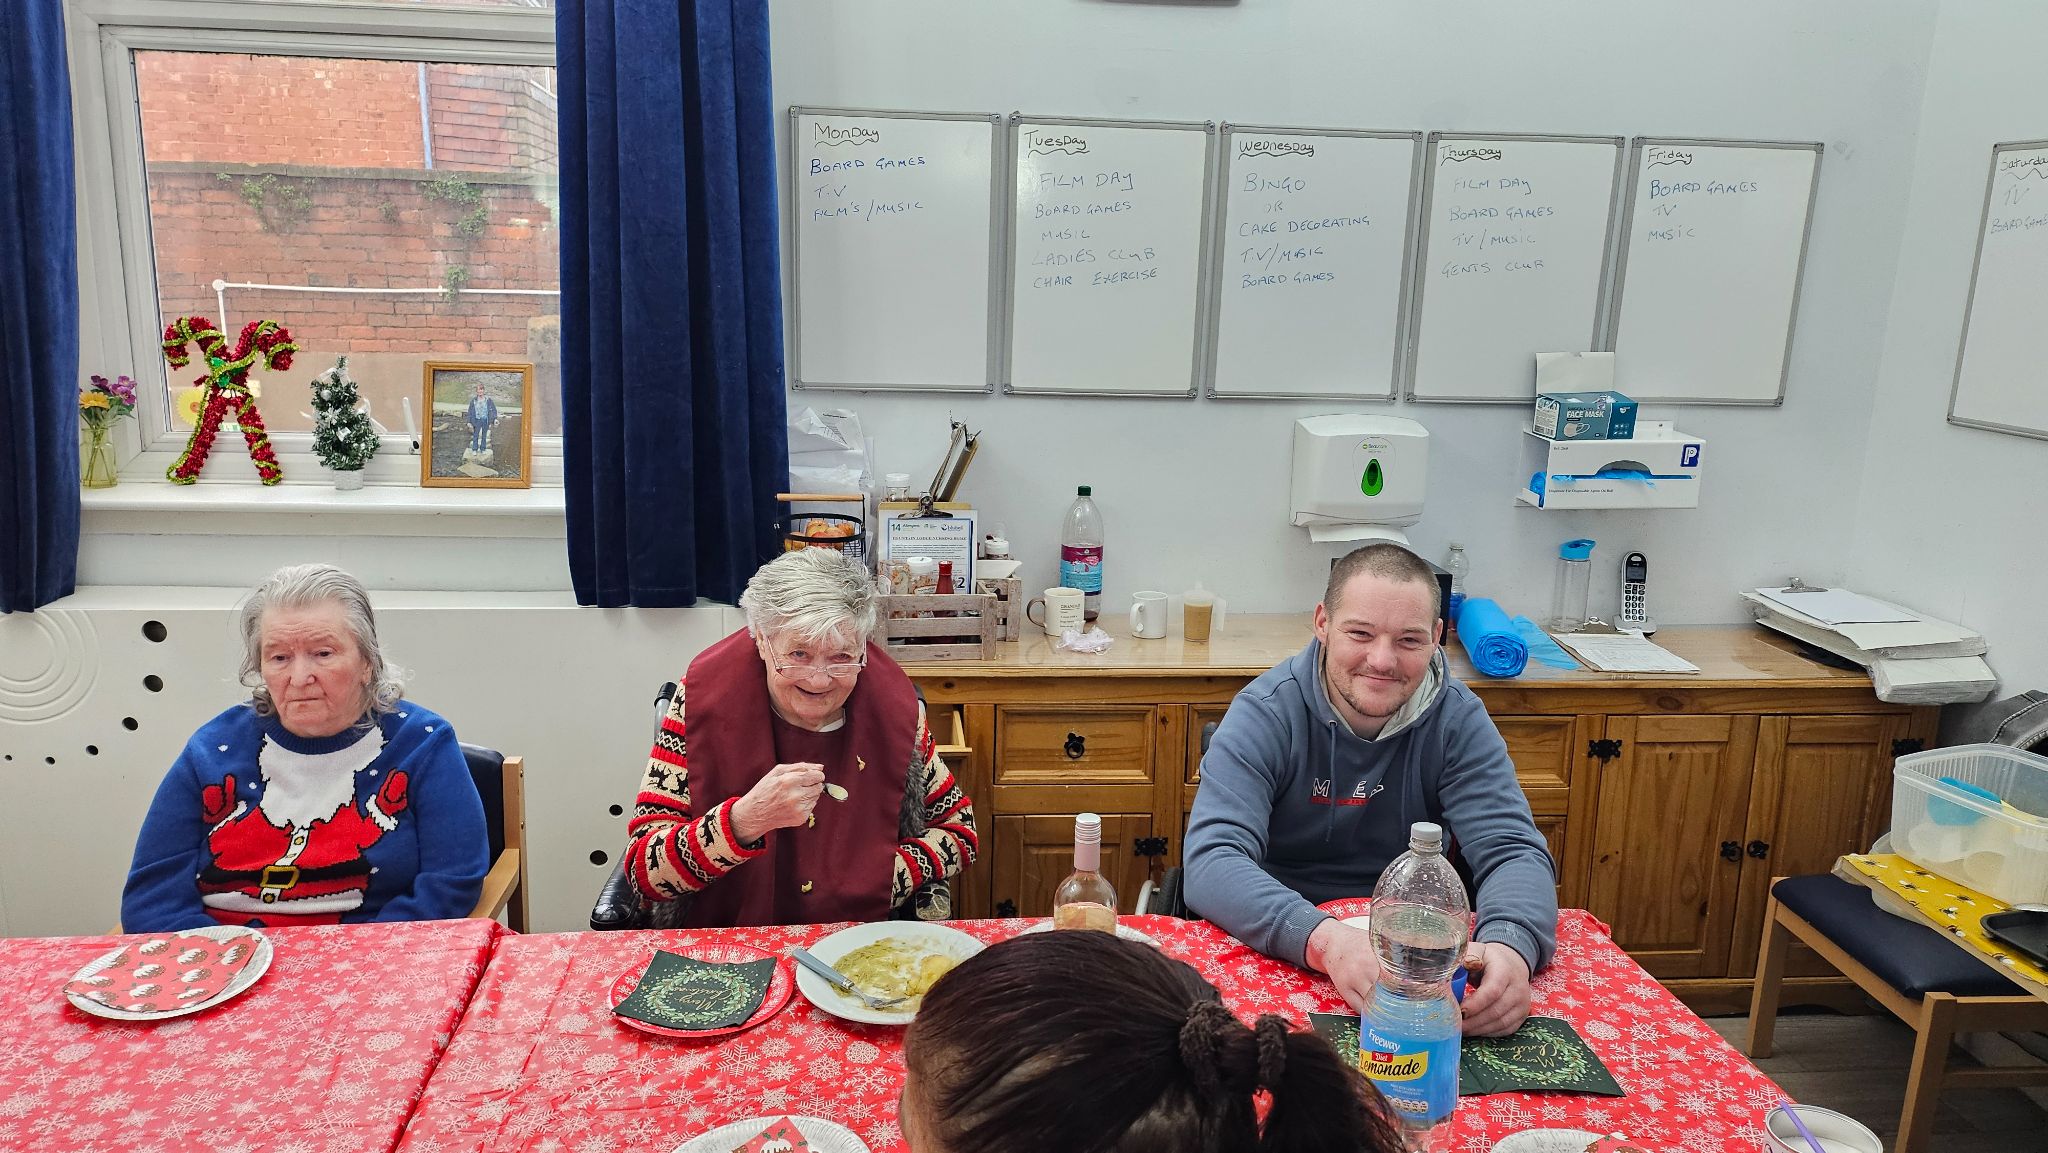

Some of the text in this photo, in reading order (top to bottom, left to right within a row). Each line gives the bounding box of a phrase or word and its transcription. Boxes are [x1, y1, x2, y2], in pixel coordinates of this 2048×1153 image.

[1648, 147, 1692, 165] Friday
[810, 156, 926, 176] BOARD GAMES
[1040, 172, 1134, 191] FILM DAY
[1243, 172, 1306, 193] BINGO
[1454, 176, 1489, 193] FILM
[1651, 180, 1758, 199] BOARD GAMES
[1035, 202, 1132, 218] BOARD GAMES
[1449, 206, 1554, 221] BOARD GAMES
[1239, 215, 1370, 237] CAKE DECORATING
[1031, 249, 1096, 267] LADIES
[1034, 268, 1158, 288] CHAIR EXERCISE
[1441, 261, 1491, 278] GENTS
[1242, 272, 1335, 289] BOARD GAMES
[1566, 410, 1605, 418] FACE MASK
[891, 523, 901, 532] 14
[1368, 1028, 1400, 1052] Freeway
[1360, 1053, 1421, 1077] Lemonade
[1375, 1052, 1388, 1062] Diet
